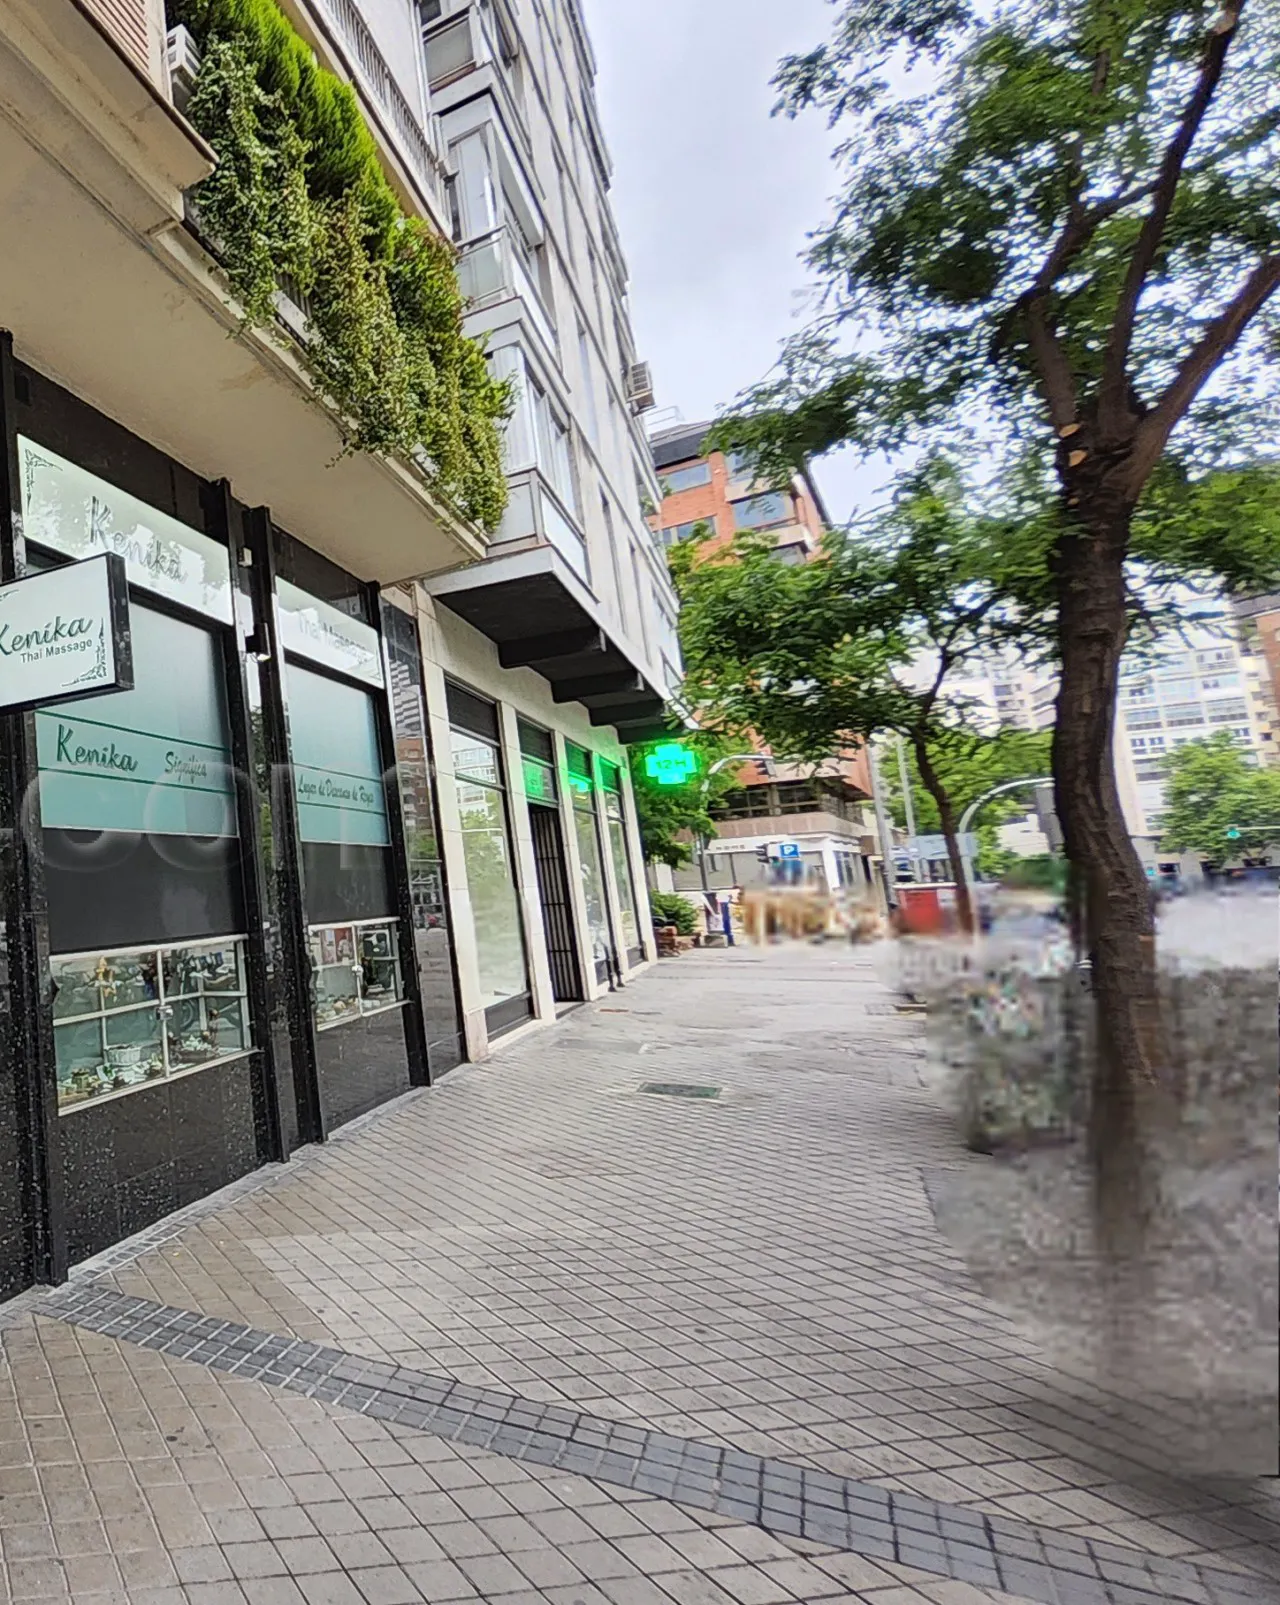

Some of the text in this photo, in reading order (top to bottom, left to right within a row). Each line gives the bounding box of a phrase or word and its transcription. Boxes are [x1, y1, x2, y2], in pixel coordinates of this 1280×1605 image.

[90, 496, 188, 584] Kenika
[20, 639, 93, 663] Thai Massage
[56, 724, 138, 772] Kenika
[783, 845, 795, 856] P
